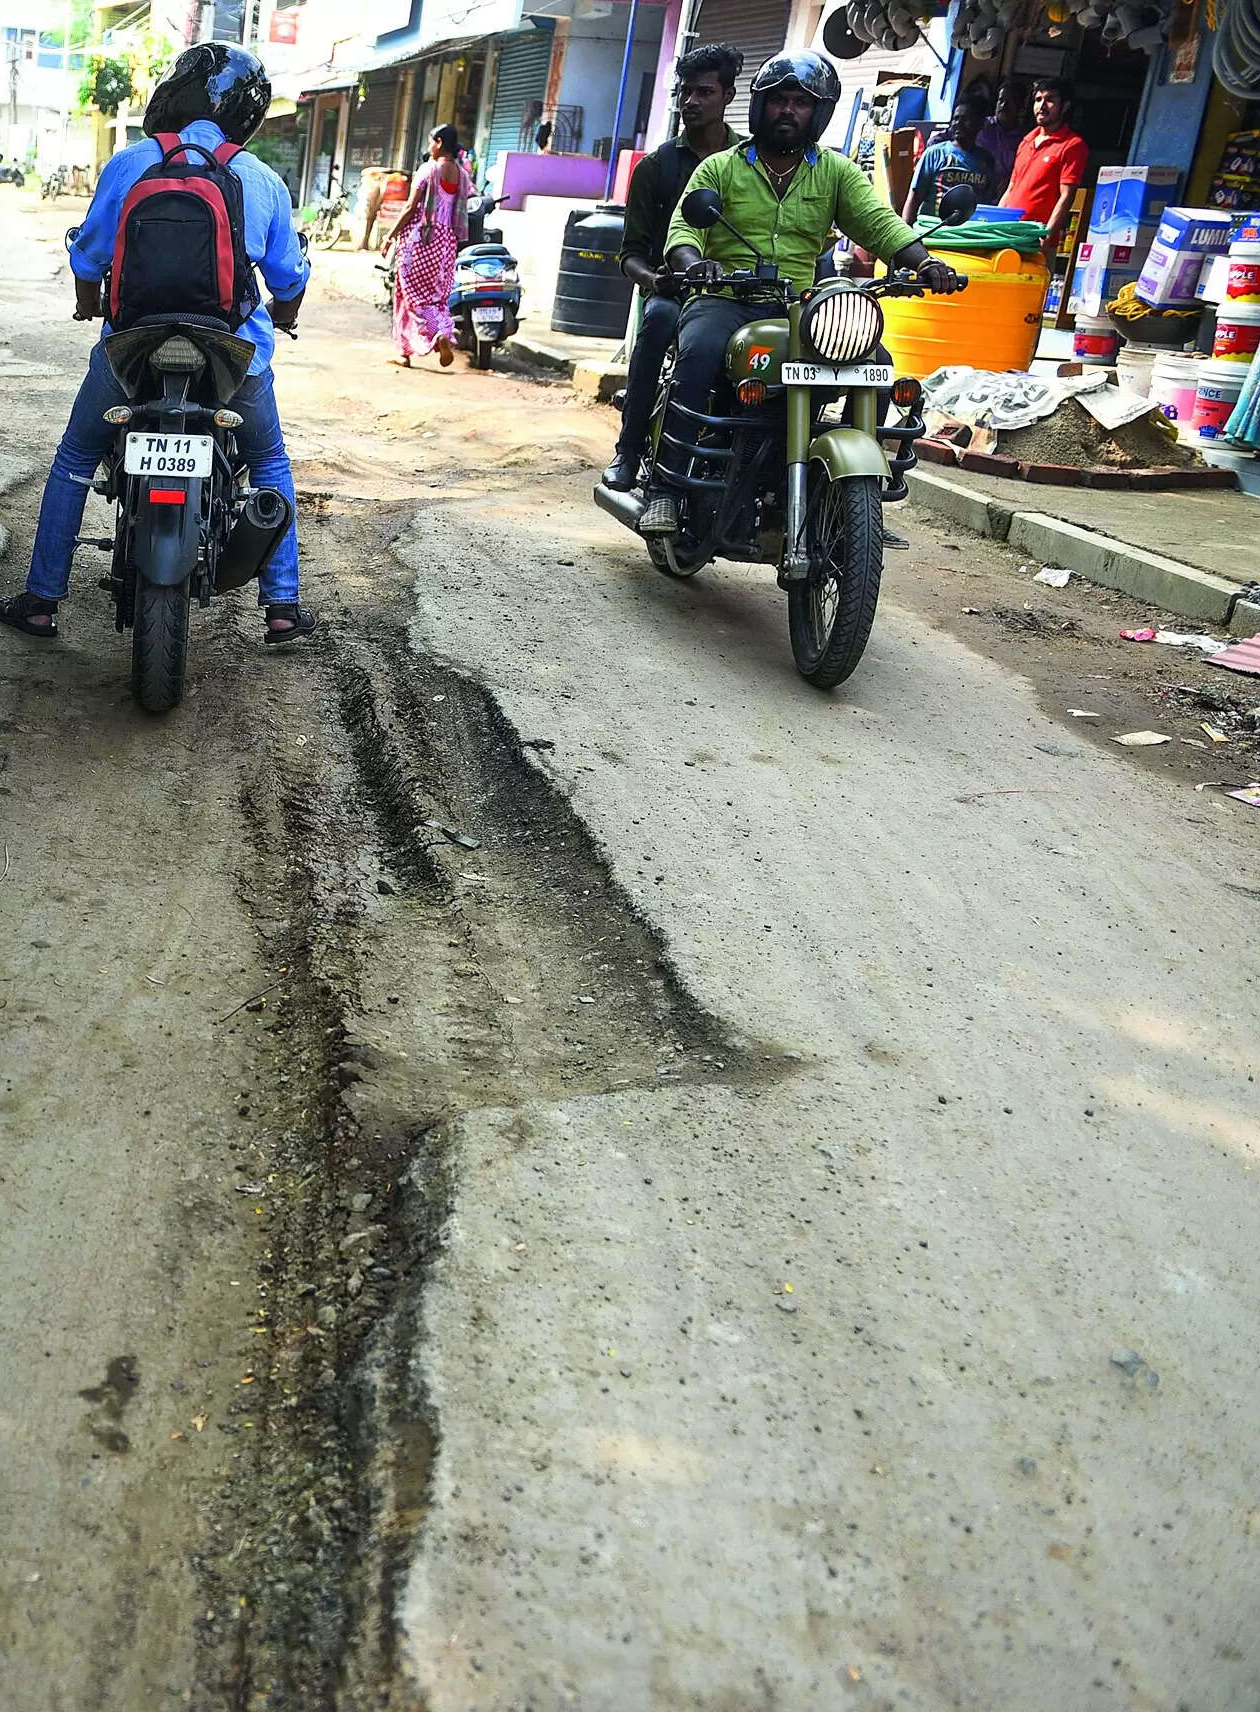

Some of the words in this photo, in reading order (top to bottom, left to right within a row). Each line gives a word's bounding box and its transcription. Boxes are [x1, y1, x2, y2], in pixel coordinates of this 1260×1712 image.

[947, 171, 987, 184] SAHARA
[749, 353, 770, 370] 49
[785, 367, 800, 380] TN
[803, 367, 816, 380] 03
[832, 368, 840, 381] Y
[863, 368, 888, 382] 1890
[146, 438, 168, 453] TN
[174, 439, 191, 453] 11
[140, 456, 152, 470] H
[157, 457, 196, 472] 0389
